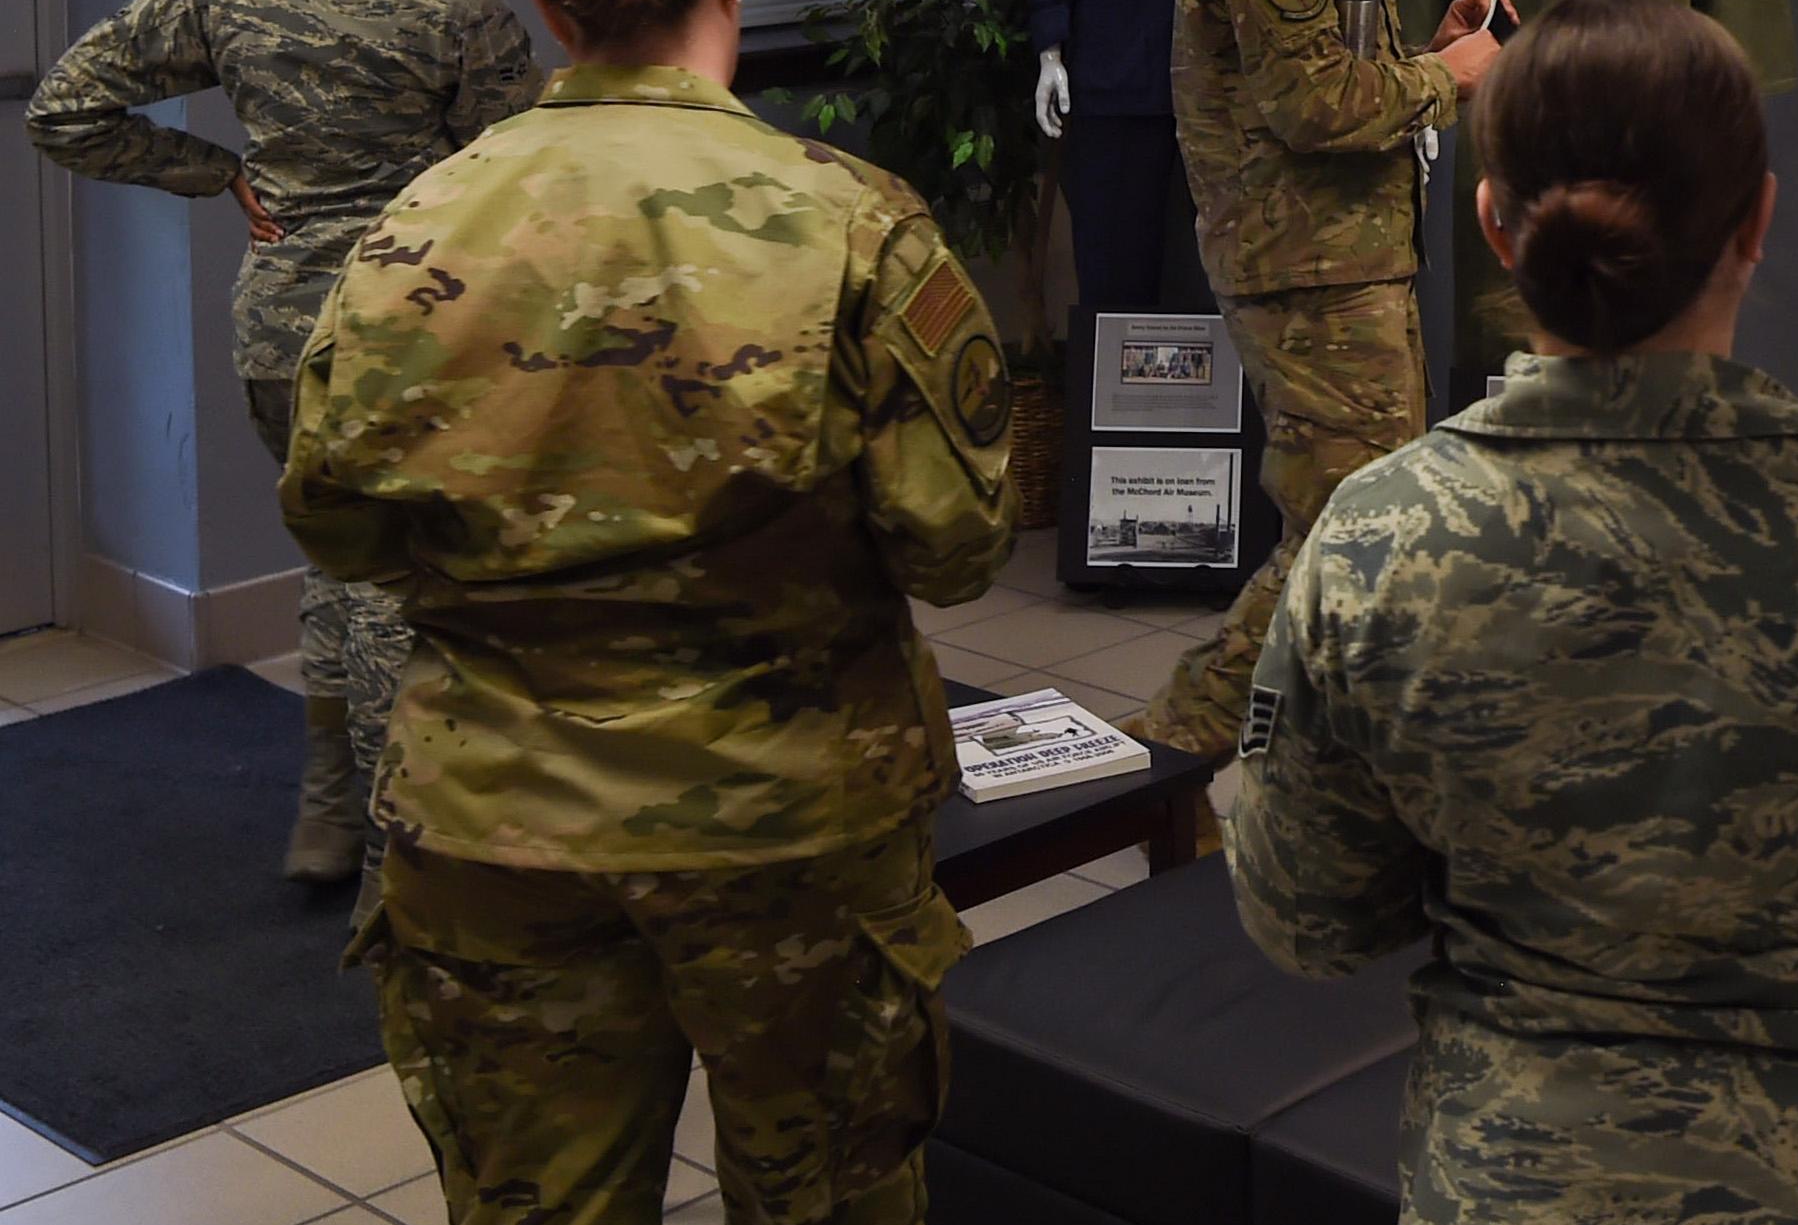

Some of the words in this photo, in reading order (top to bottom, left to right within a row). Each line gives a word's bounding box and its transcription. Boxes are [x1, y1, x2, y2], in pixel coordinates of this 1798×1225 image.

[1111, 476, 1126, 484] This
[1129, 477, 1154, 485] exhibit
[965, 753, 1038, 772] OPERATION
[1038, 746, 1070, 757] DEEP
[1073, 735, 1120, 750] FREEZE
